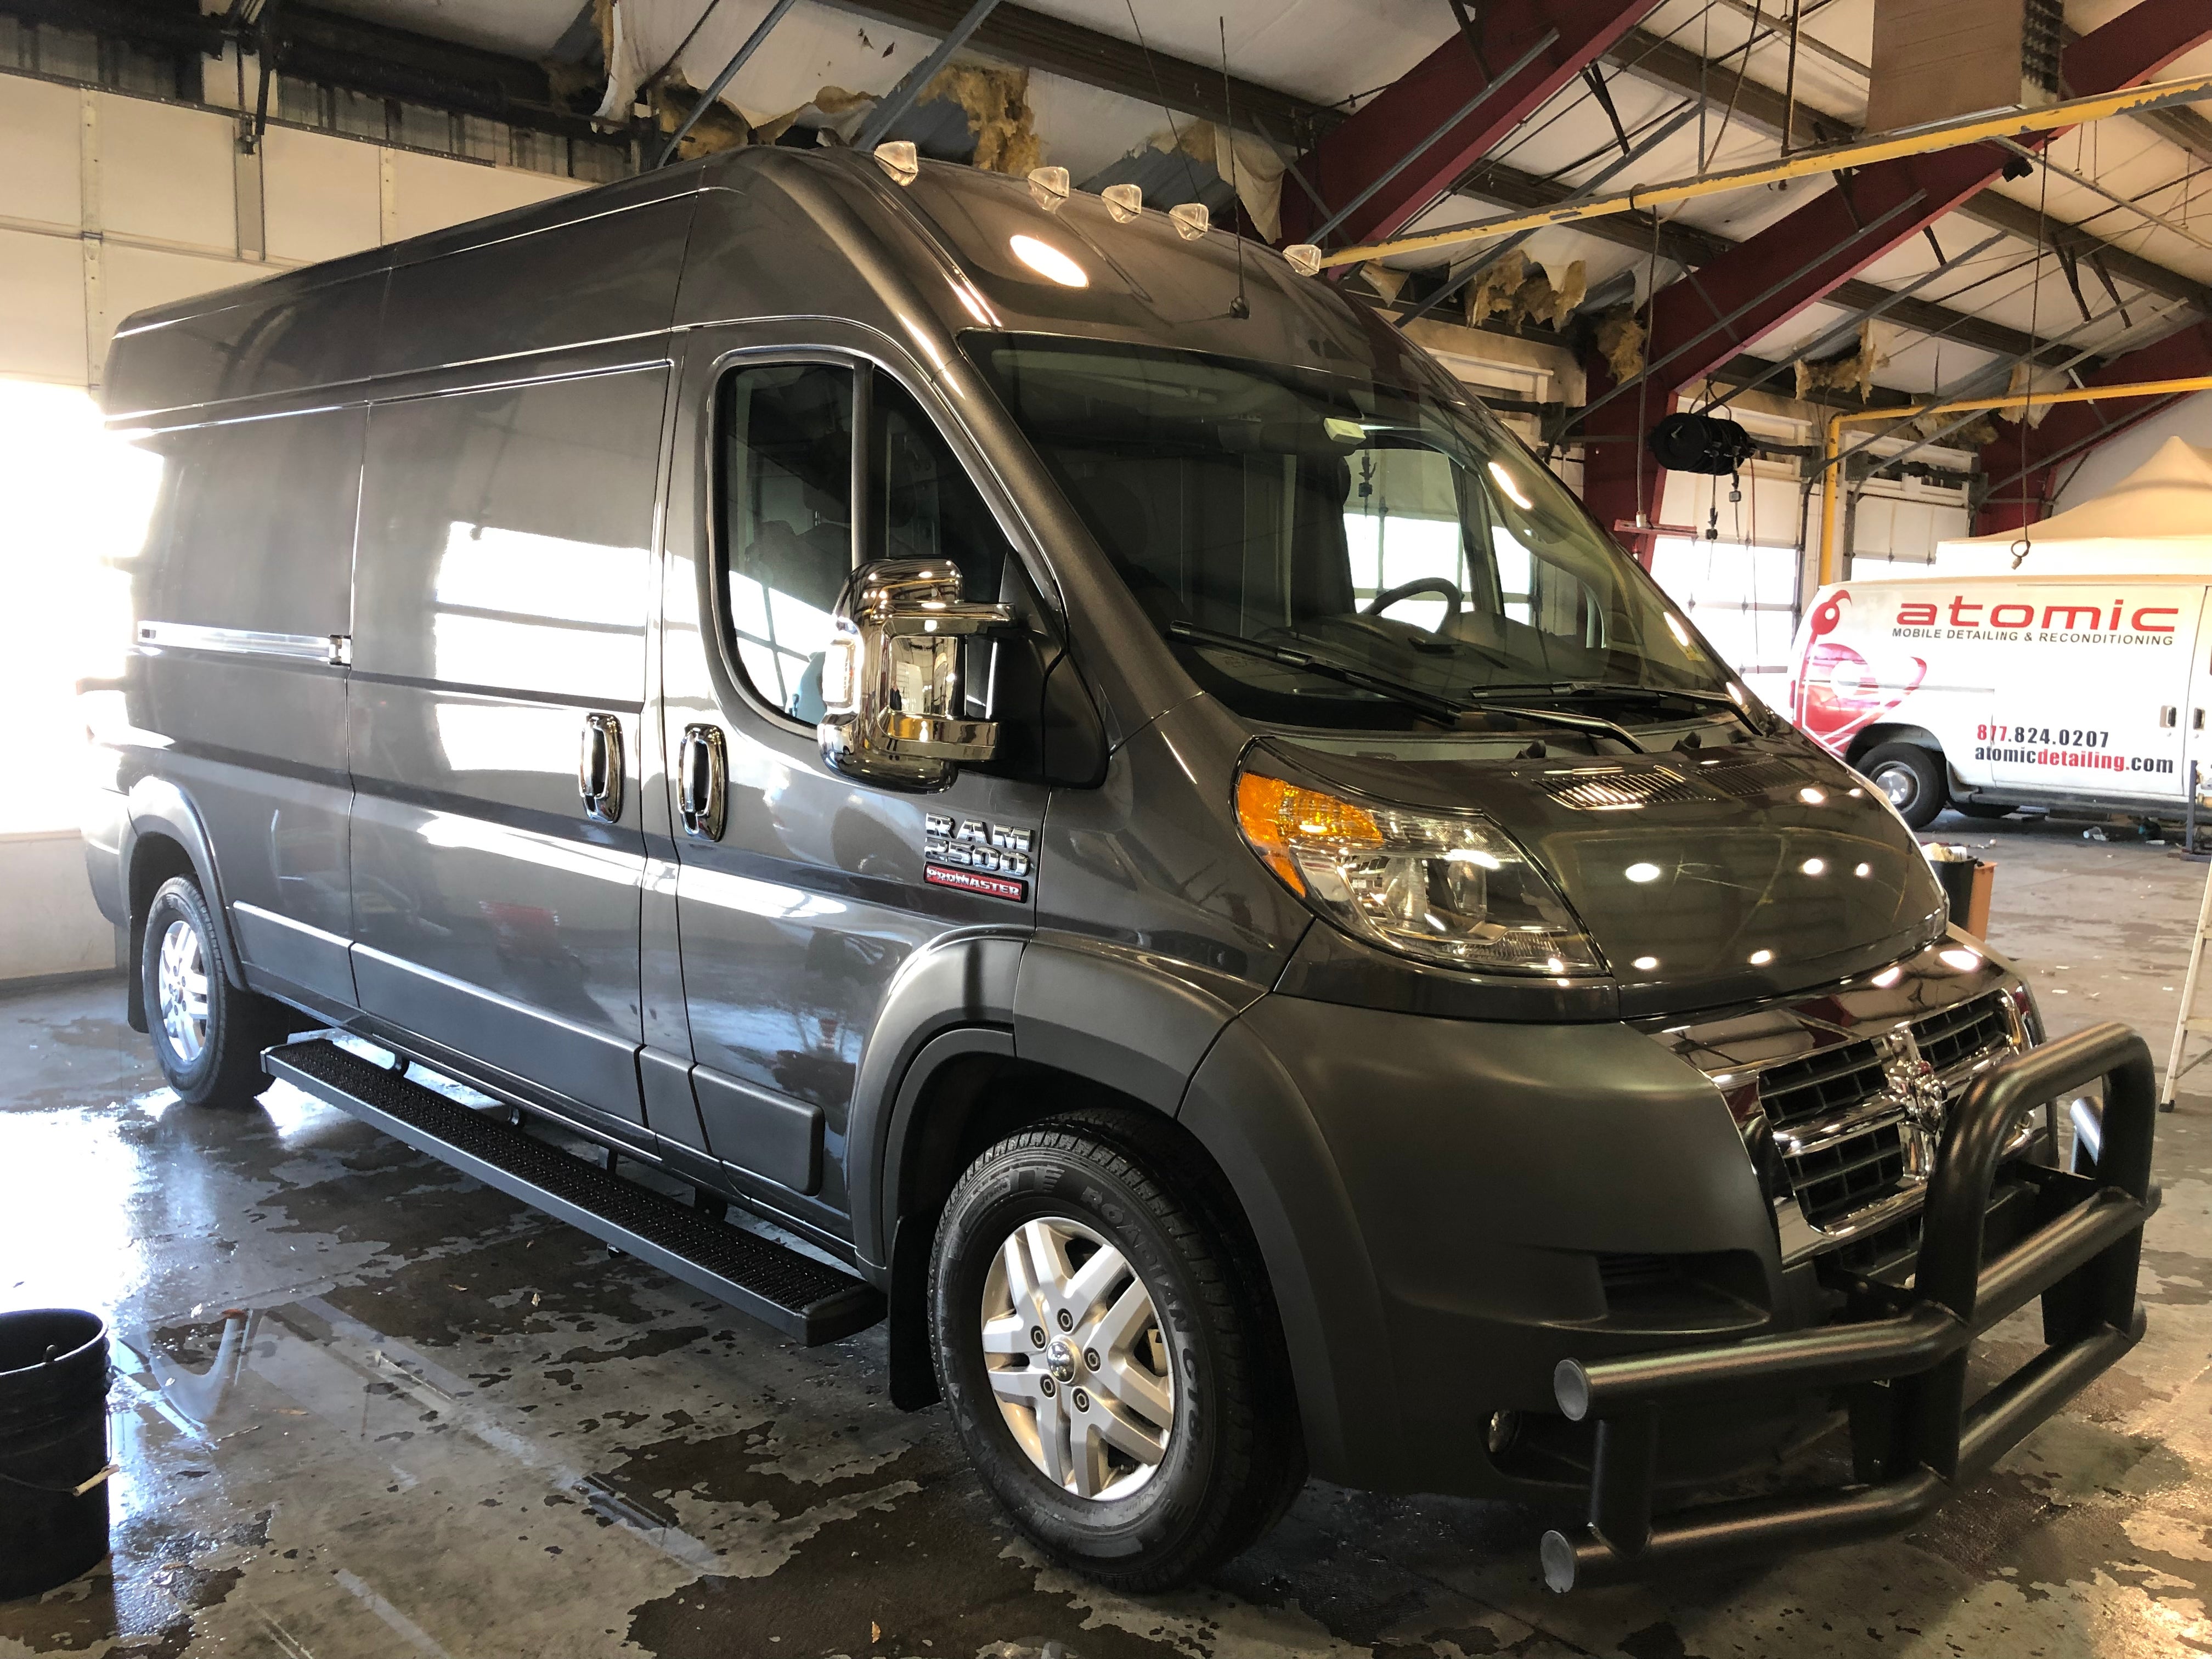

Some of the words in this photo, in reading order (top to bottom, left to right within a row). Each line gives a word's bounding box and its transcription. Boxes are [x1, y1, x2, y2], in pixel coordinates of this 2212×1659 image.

[1896, 595, 2179, 632] atomic
[1892, 628, 1942, 639] MOBILE
[1946, 629, 2018, 641] DETAILING
[2024, 631, 2033, 642] &
[2039, 632, 2174, 646] RECONDITIONING
[1977, 724, 2109, 748] 877.824.0207
[1974, 746, 2174, 774] atomicdetailing.com
[925, 812, 1034, 852] RAM
[924, 837, 1031, 877] 2500
